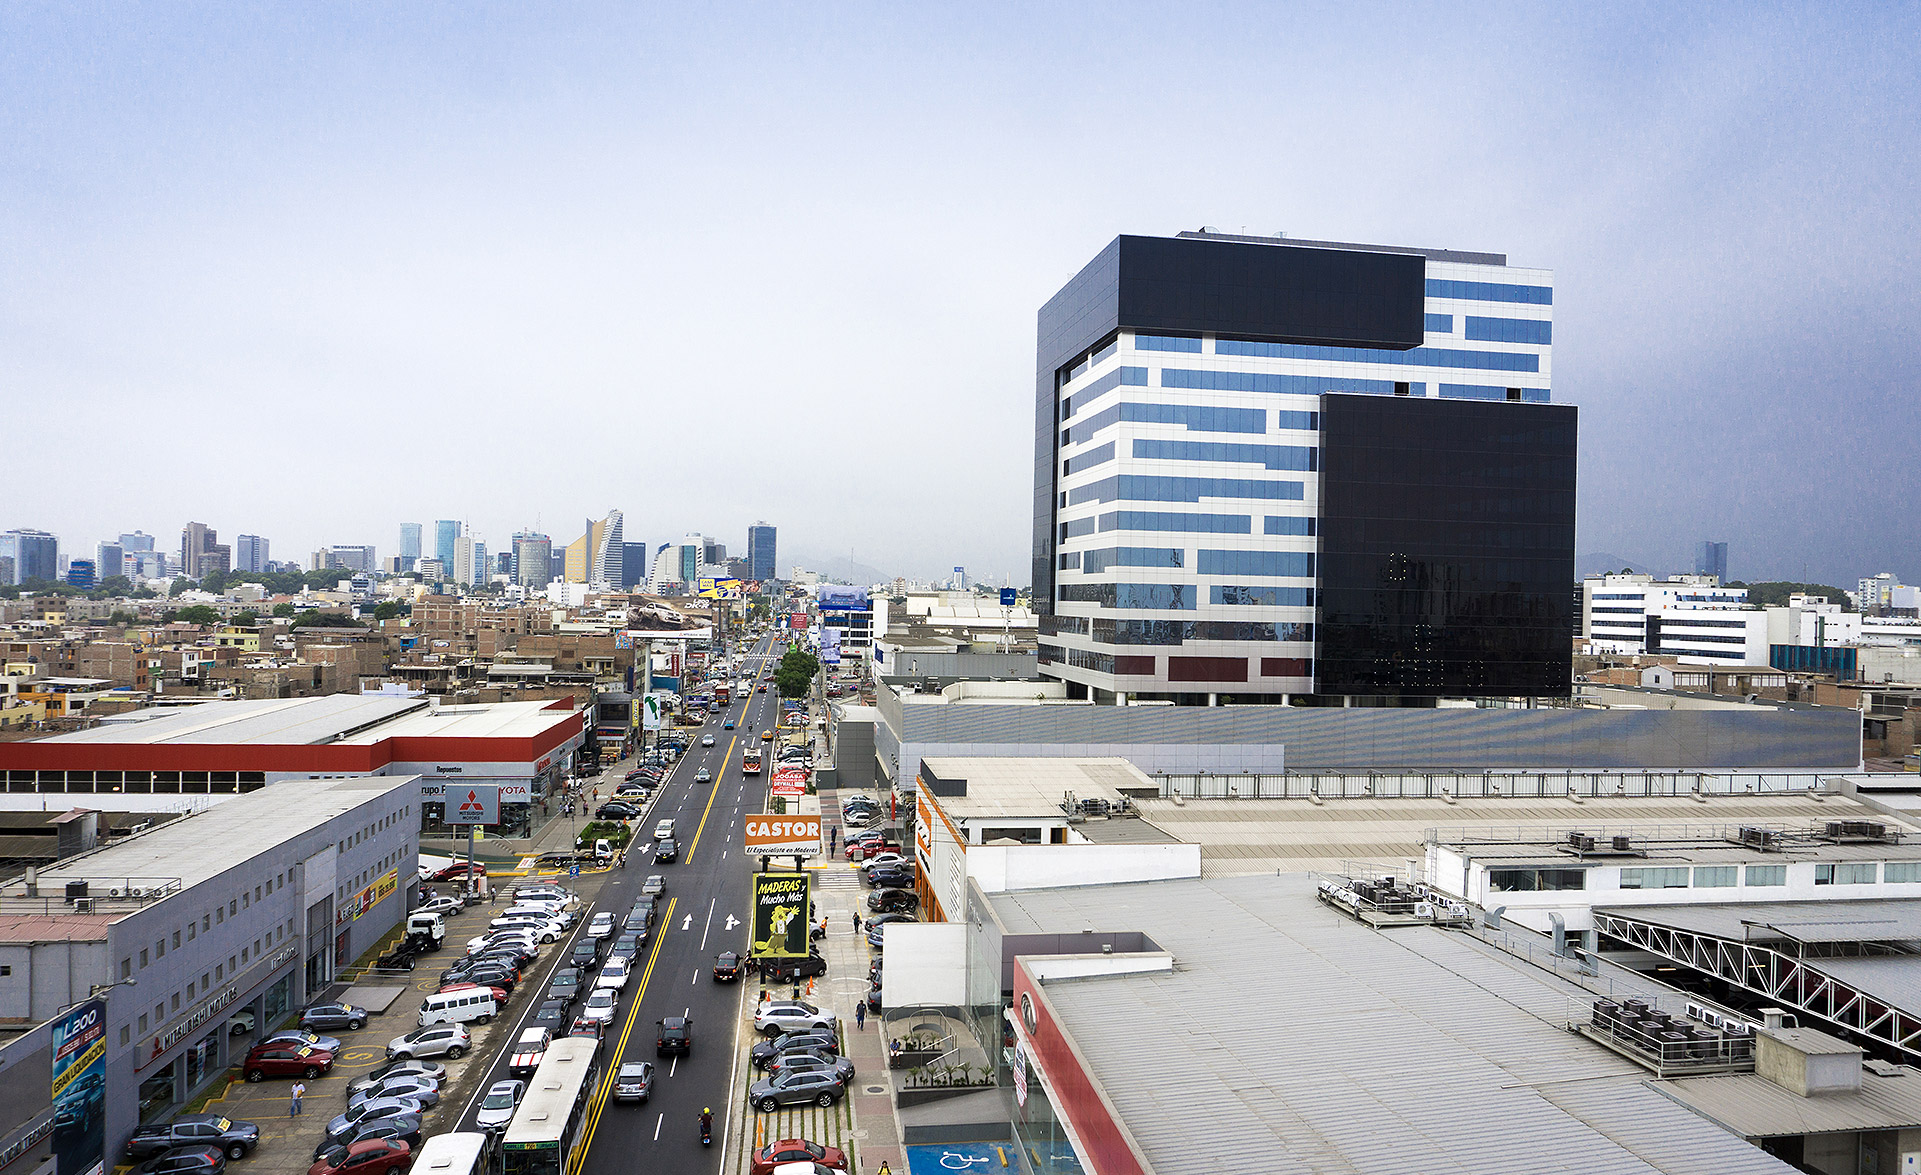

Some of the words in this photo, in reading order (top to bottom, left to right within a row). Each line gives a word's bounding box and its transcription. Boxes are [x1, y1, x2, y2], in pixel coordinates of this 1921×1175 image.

[436, 765, 463, 774] Repuestos
[421, 786, 440, 796] rupo
[500, 786, 526, 794] YOTA
[746, 822, 819, 837] CASTOR
[758, 880, 802, 894] MADERAS
[760, 894, 785, 905] Mucho
[787, 891, 803, 902] Más
[63, 1009, 97, 1040] L200
[162, 1008, 207, 1050] MITSUBISHI
[209, 987, 238, 1017] MOTORS
[54, 1071, 71, 1093] GRAN
